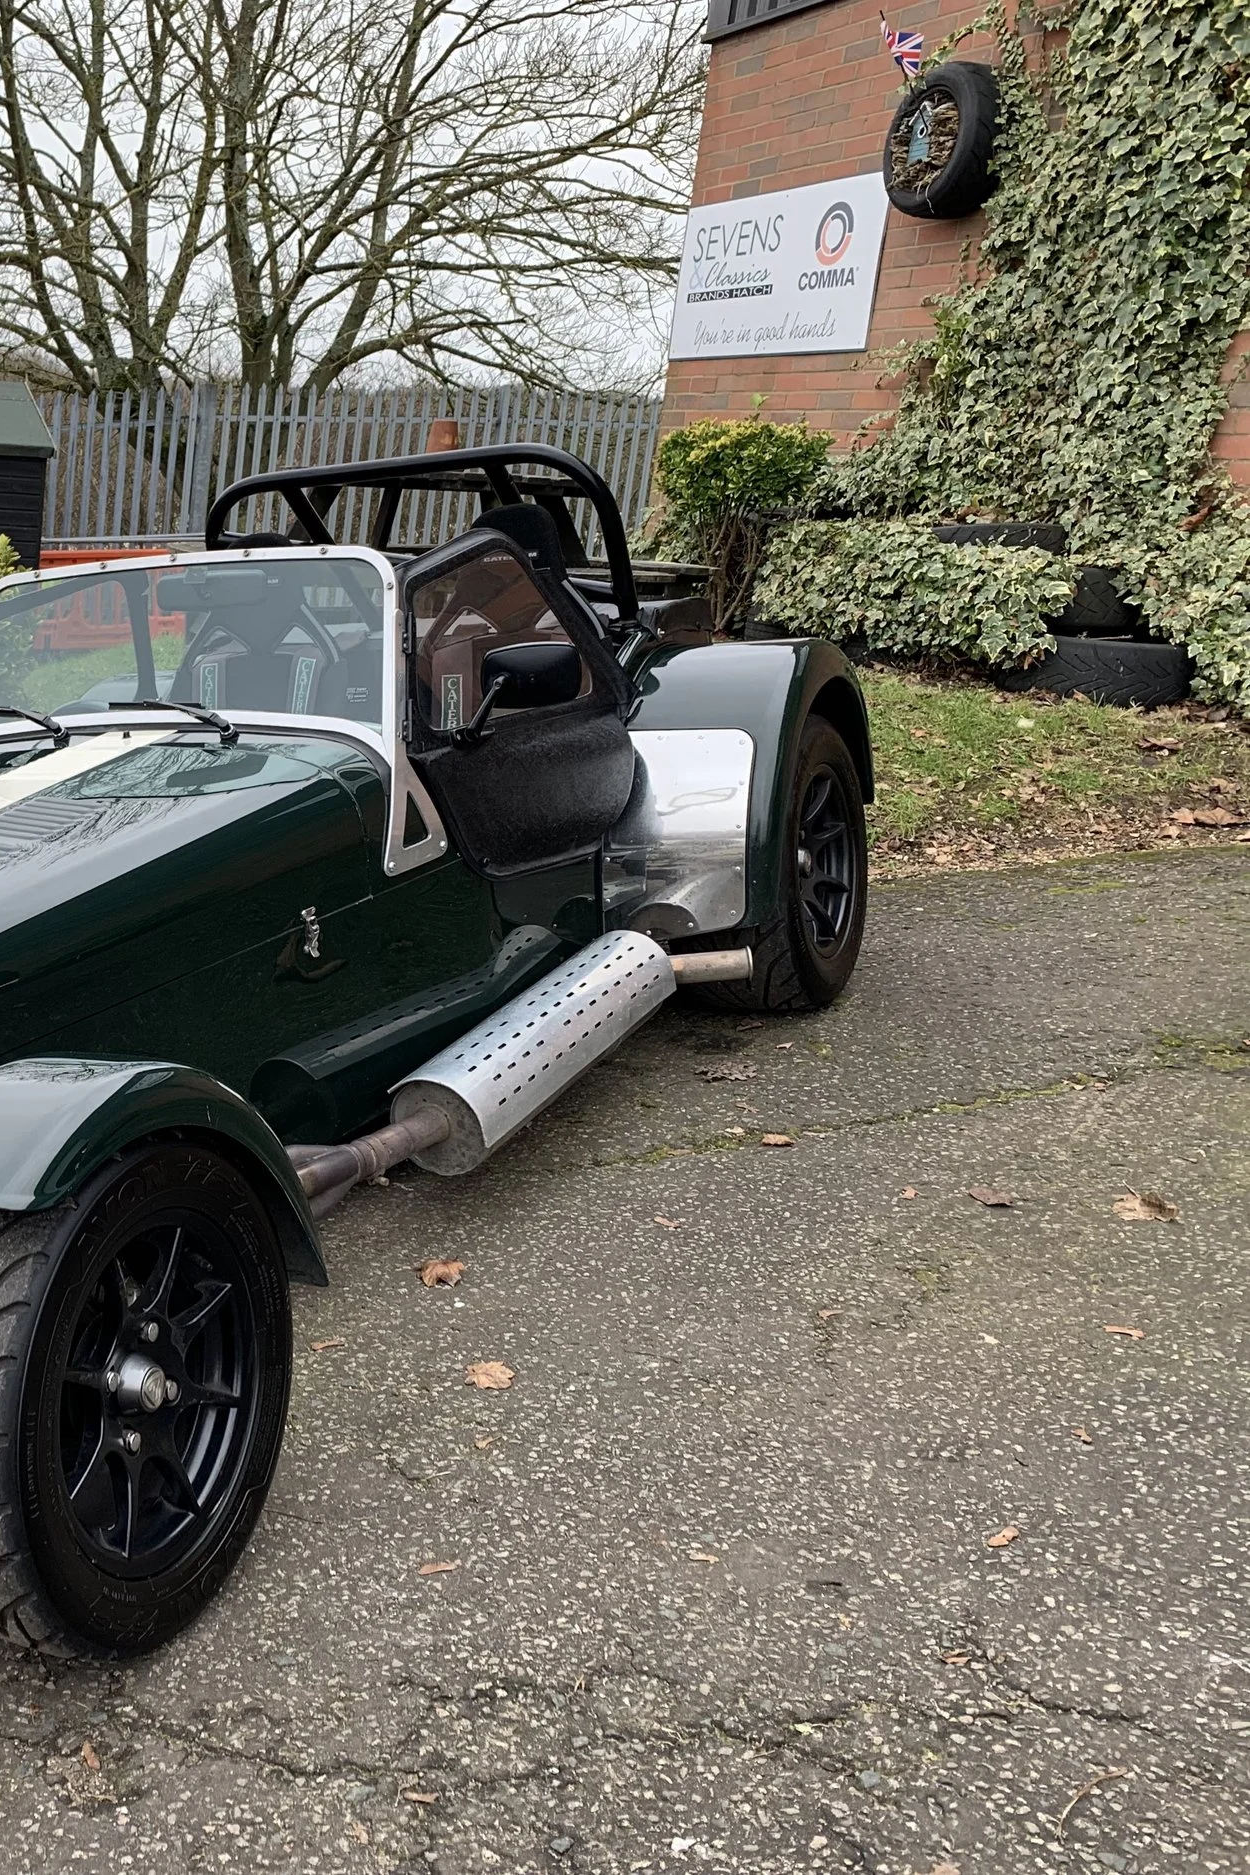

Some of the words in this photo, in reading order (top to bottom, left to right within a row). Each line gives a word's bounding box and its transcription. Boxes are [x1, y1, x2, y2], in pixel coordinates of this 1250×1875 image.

[693, 214, 784, 263] SEVENS
[704, 261, 771, 289] Classics
[798, 267, 855, 291] COMMA
[688, 290, 730, 303] BRANDS
[732, 286, 772, 298] HATCH
[694, 318, 734, 354] You're
[737, 324, 751, 346] in
[753, 312, 790, 352] good
[789, 308, 836, 340] hands
